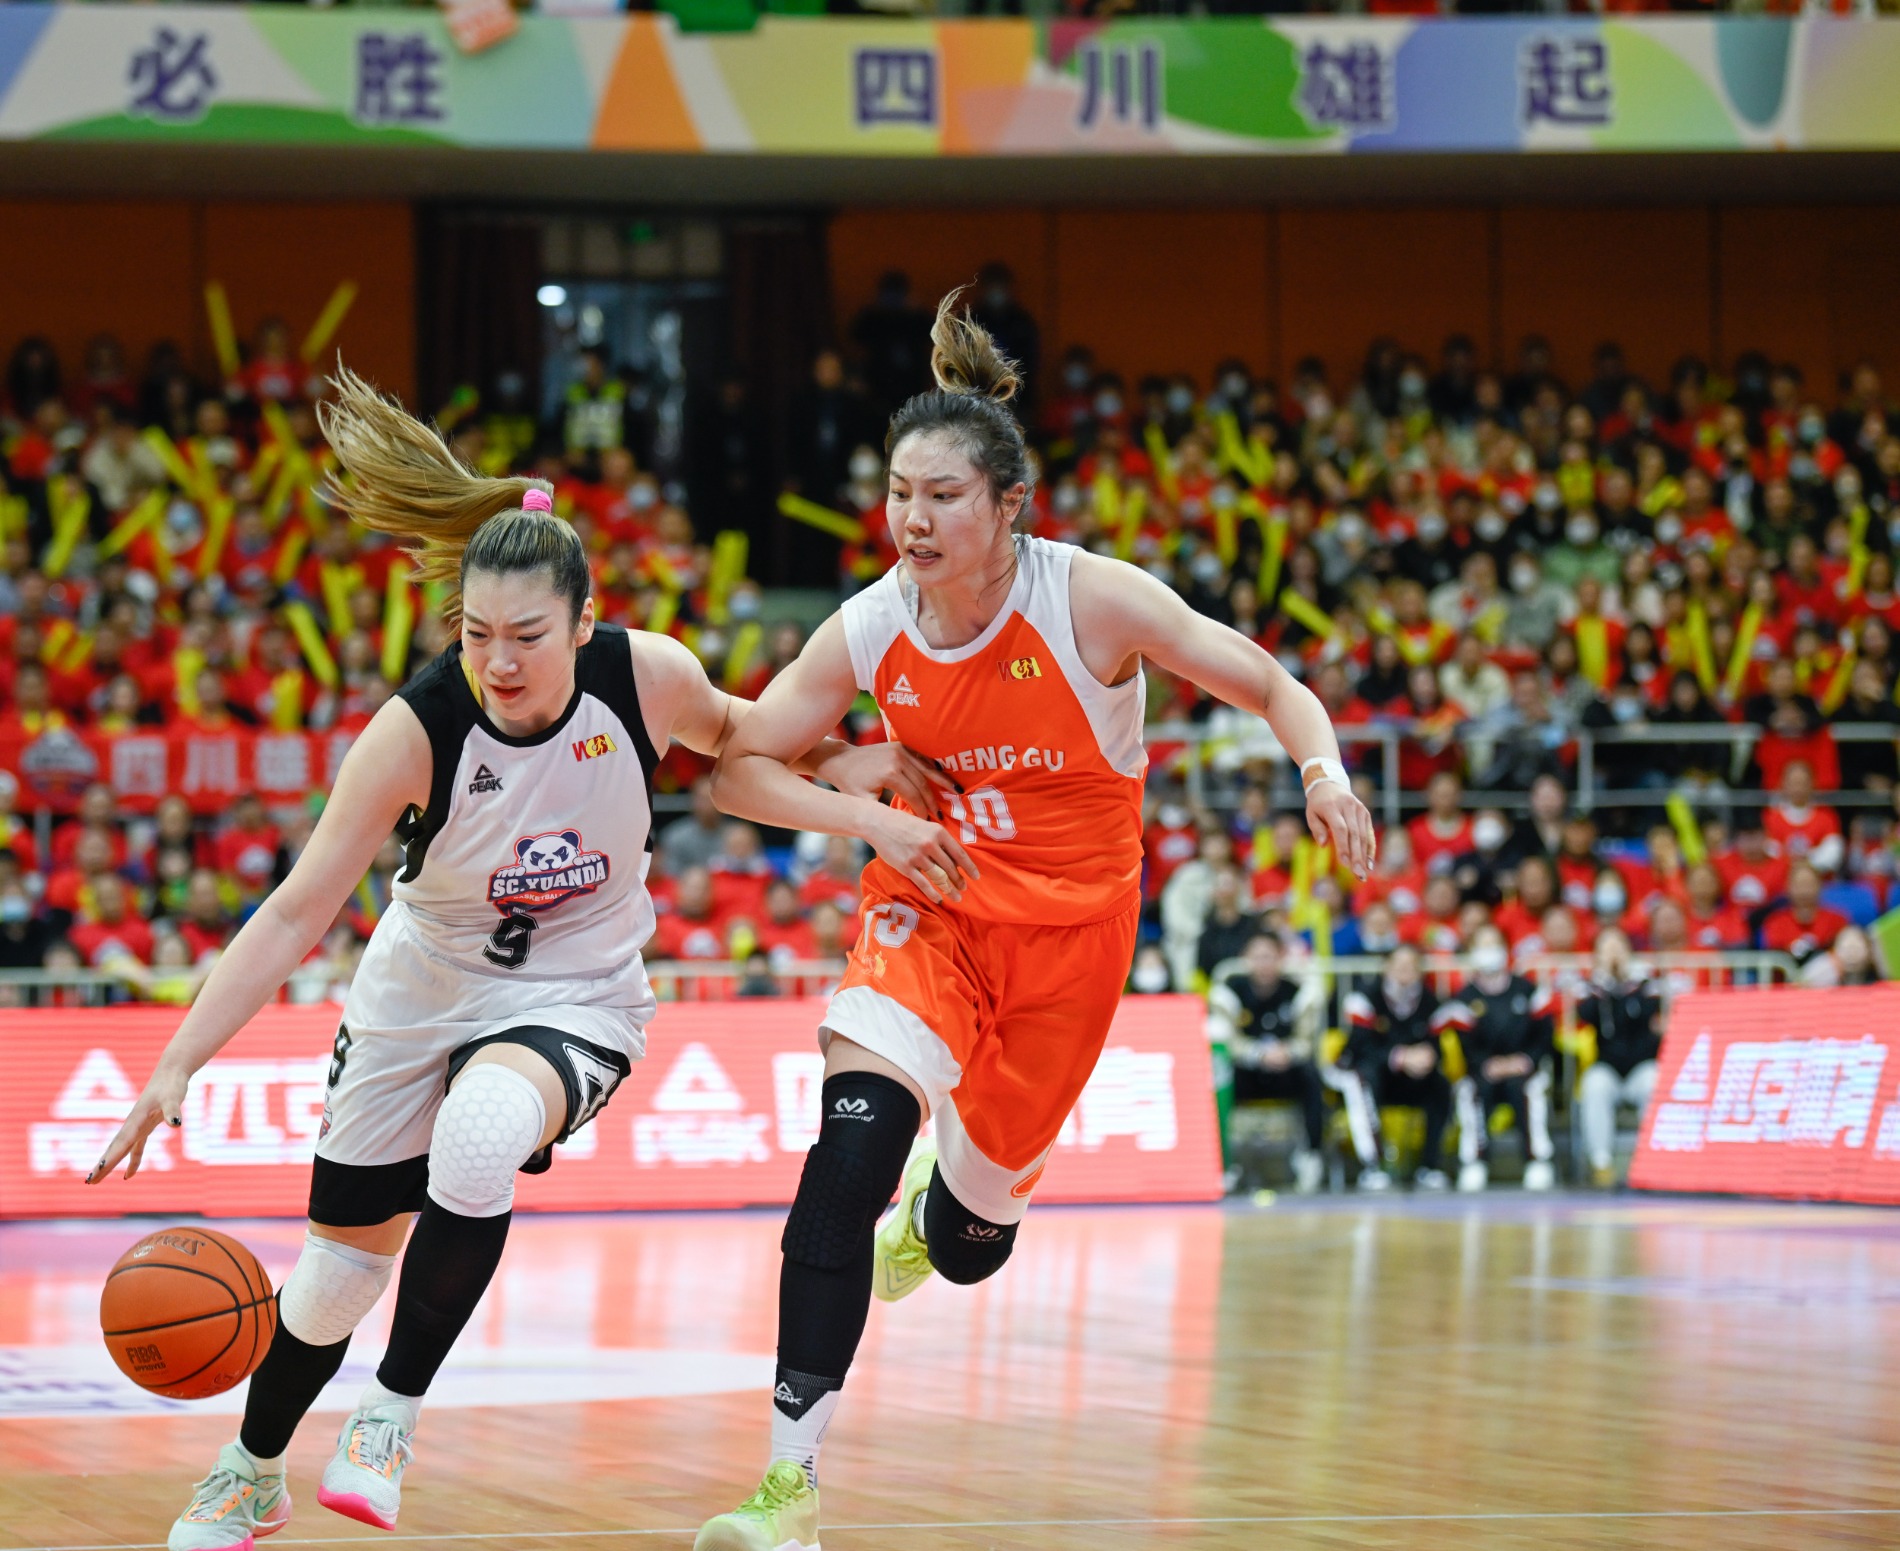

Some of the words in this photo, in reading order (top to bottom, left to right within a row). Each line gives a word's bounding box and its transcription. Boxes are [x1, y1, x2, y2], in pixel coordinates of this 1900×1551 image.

[887, 692, 920, 707] PEAK
[1022, 747, 1065, 772] GU
[468, 777, 504, 796] PEAK
[940, 785, 1018, 844] 10
[482, 913, 539, 970] 9
[125, 1343, 163, 1364] FIBA
